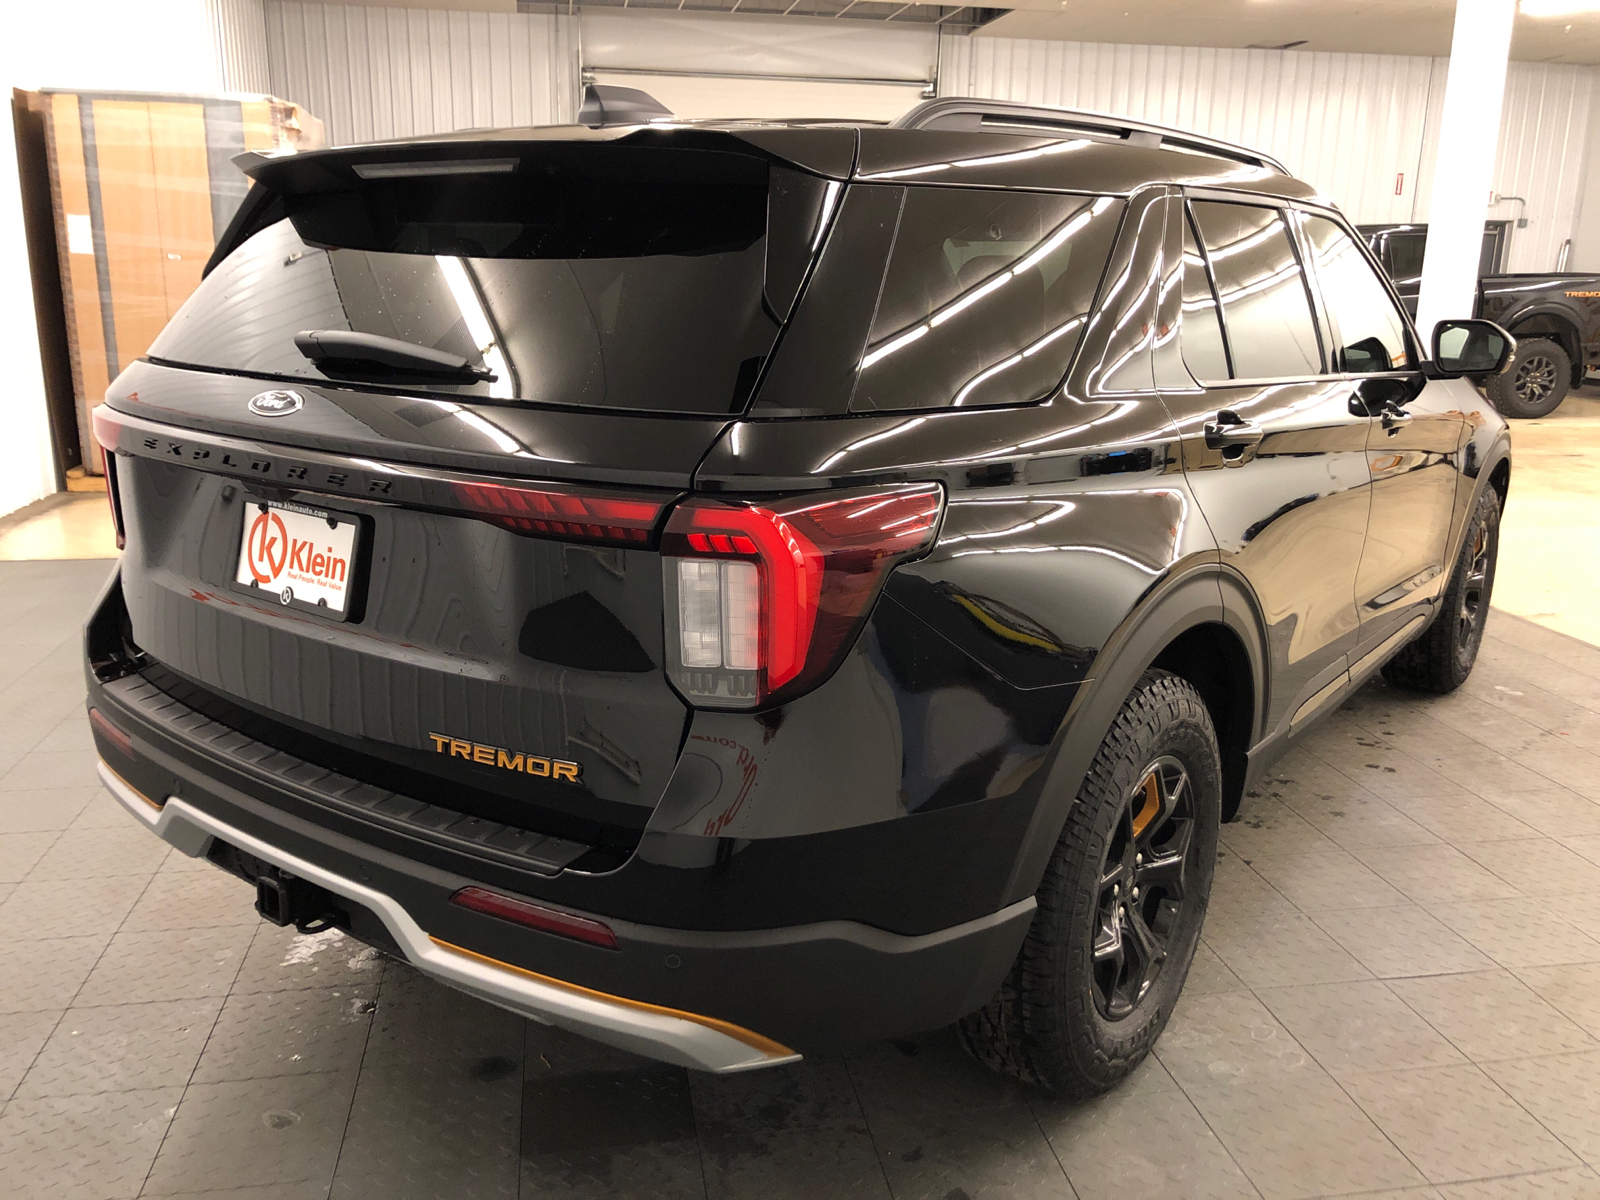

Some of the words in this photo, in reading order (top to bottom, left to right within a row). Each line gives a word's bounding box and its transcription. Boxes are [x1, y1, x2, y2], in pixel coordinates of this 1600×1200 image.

[143, 437, 393, 494] EXPLORER
[267, 500, 328, 518] www.kleinauto.com
[287, 571, 299, 580] Real
[317, 578, 328, 587] Real
[289, 538, 346, 582] Klein
[428, 732, 583, 784] TREMOR
